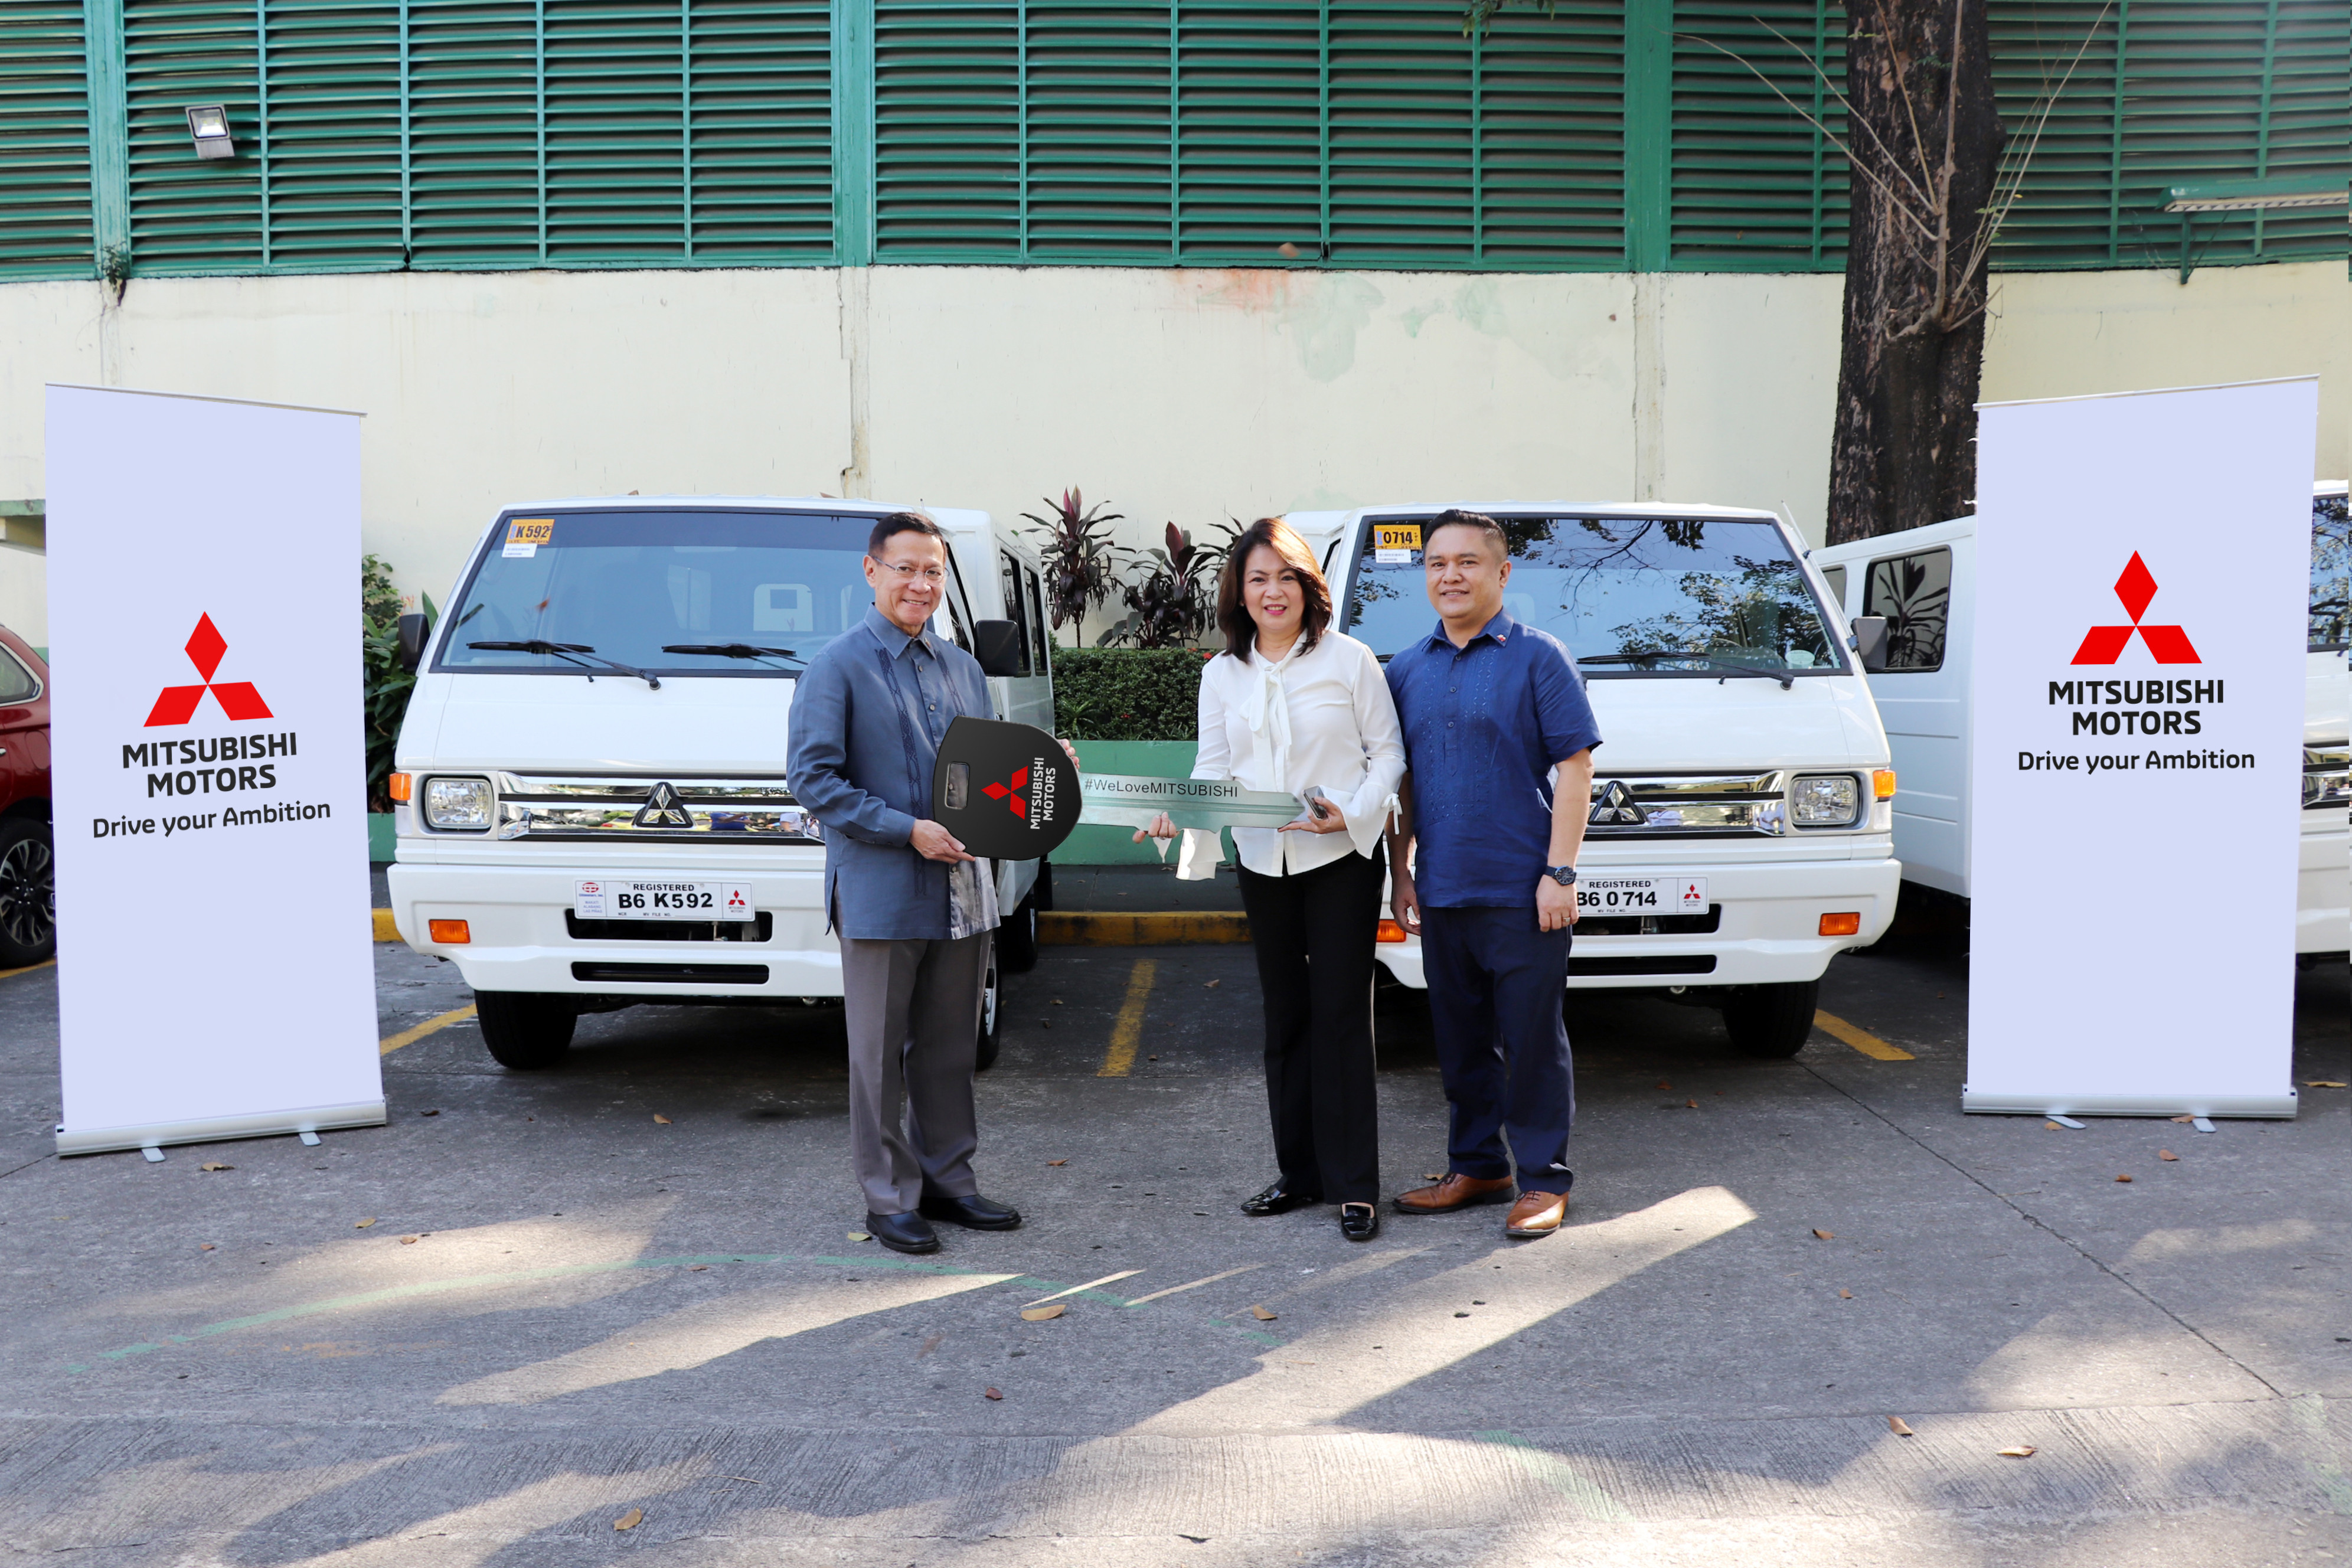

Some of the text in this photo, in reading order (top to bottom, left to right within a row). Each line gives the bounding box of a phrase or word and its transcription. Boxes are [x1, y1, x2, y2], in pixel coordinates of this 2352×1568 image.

[1383, 531, 1413, 544] 0714
[2049, 680, 2224, 705] MITSUBISHI
[2073, 710, 2201, 736] MOTORS
[122, 732, 297, 769] MITSUBISHI
[2018, 749, 2255, 775] Drive your Ambition
[148, 764, 276, 798] MOTORS
[1030, 756, 1044, 829] MITSUBISHI
[1043, 767, 1056, 821] MOTORS
[1084, 778, 1238, 798] #WeLoveMITSUBISHI
[93, 801, 331, 838] Drive your Ambition
[618, 893, 645, 909] B6
